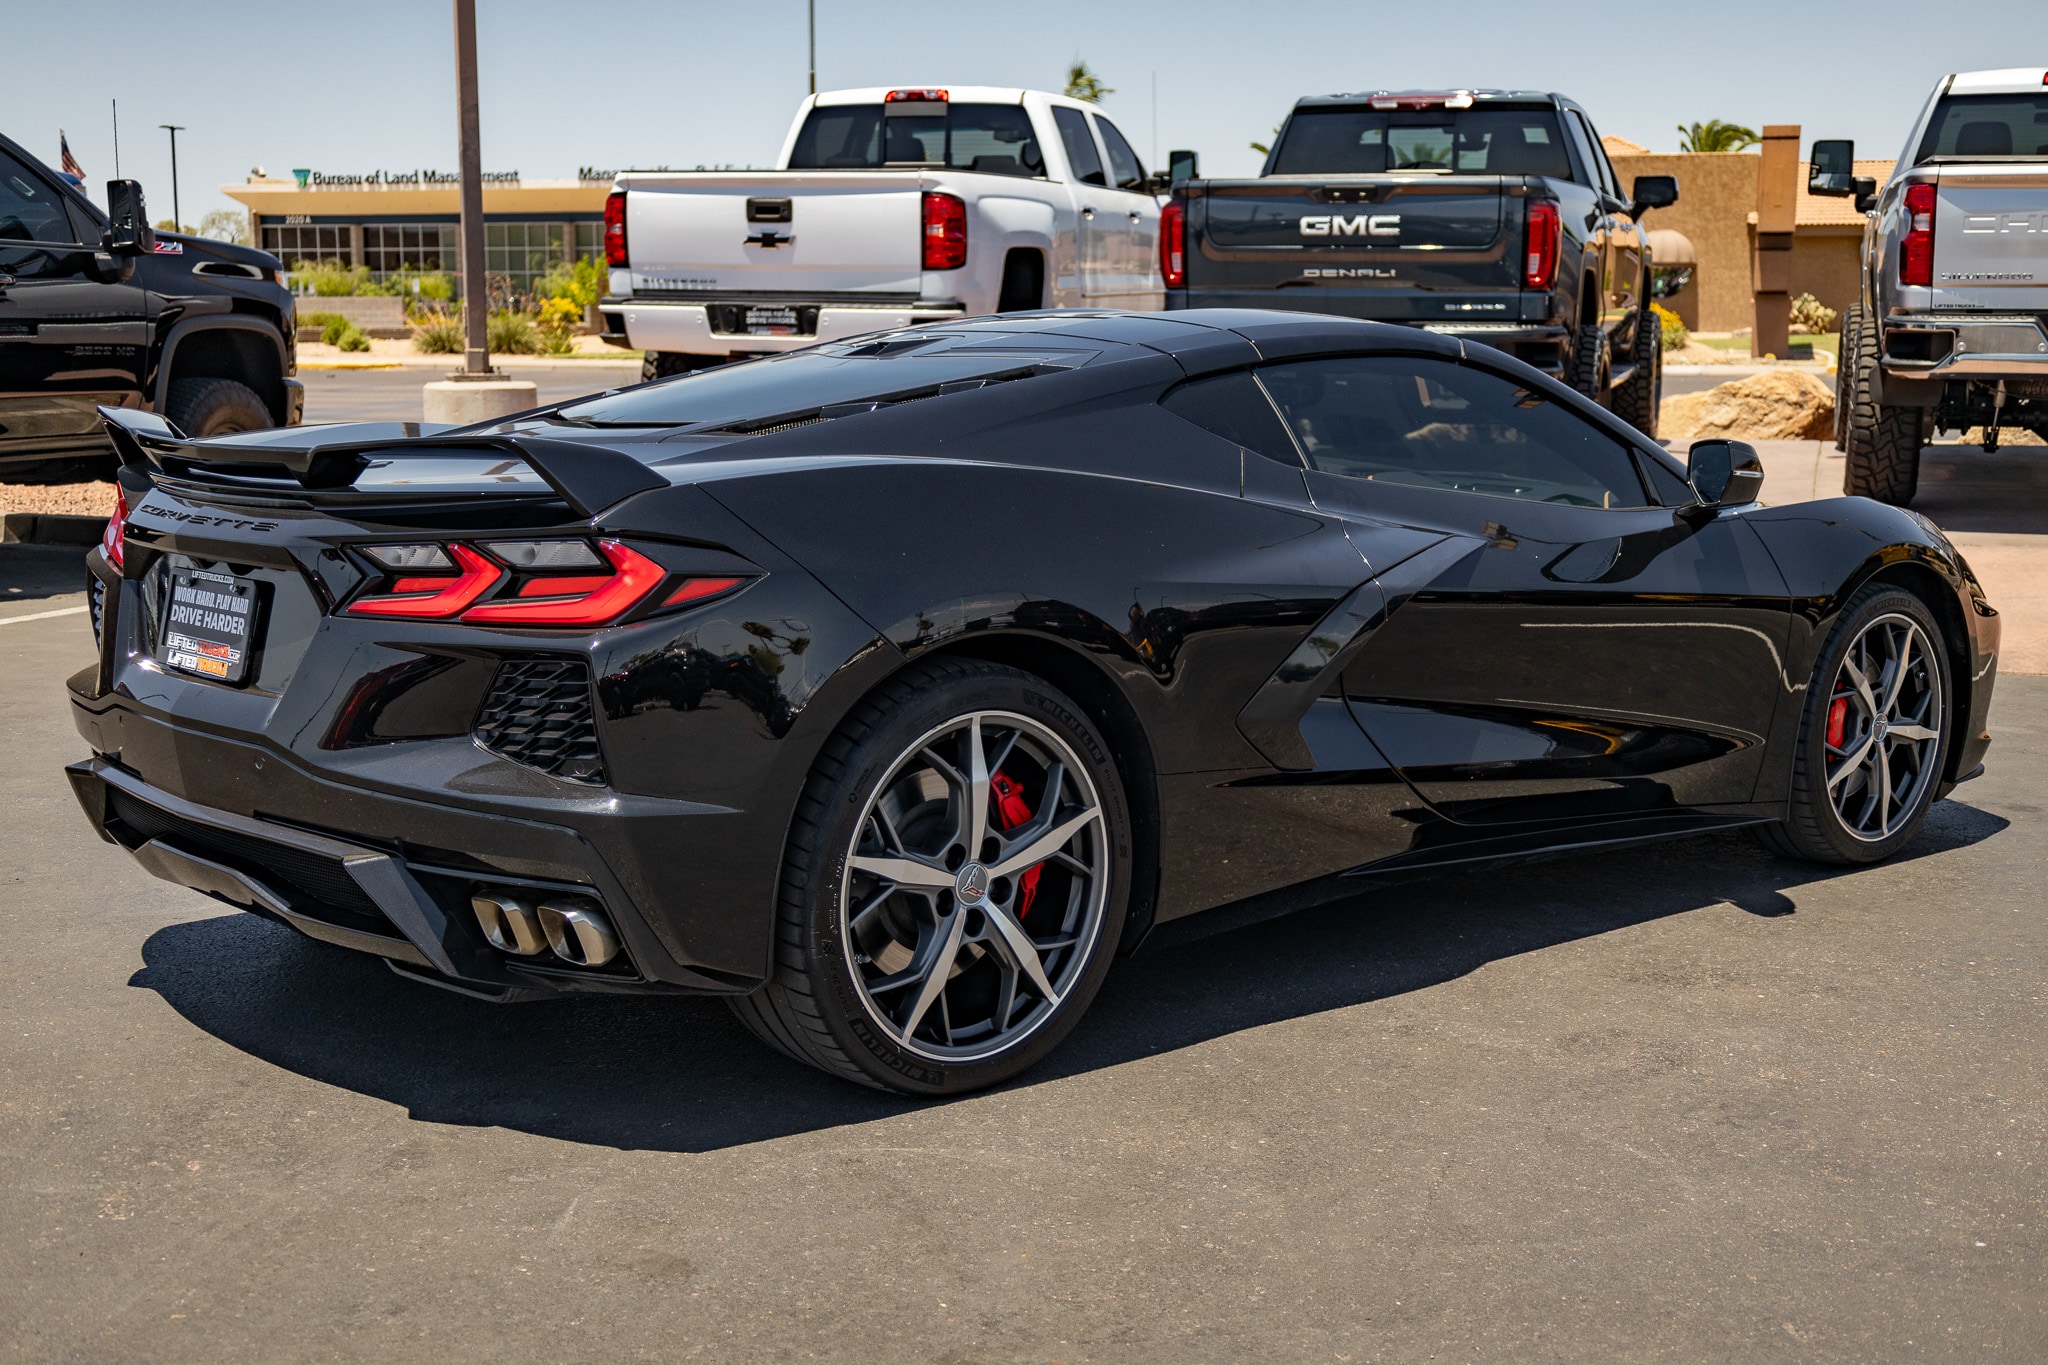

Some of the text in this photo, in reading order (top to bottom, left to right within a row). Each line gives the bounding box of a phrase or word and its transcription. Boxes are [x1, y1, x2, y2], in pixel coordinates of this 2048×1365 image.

[313, 169, 520, 185] Bureau of Land Manament
[1299, 214, 1401, 236] GMC
[1303, 268, 1396, 278] DENALI
[139, 504, 279, 532] CORVETTE
[191, 570, 235, 585] LIFTEDTRUCKS.COM
[174, 585, 250, 614] WORK HARD. PLAY HARD
[170, 604, 245, 635] DRIVE HARDER
[1042, 699, 1104, 765] MICHELIN
[853, 1022, 923, 1079] MICHELIN
